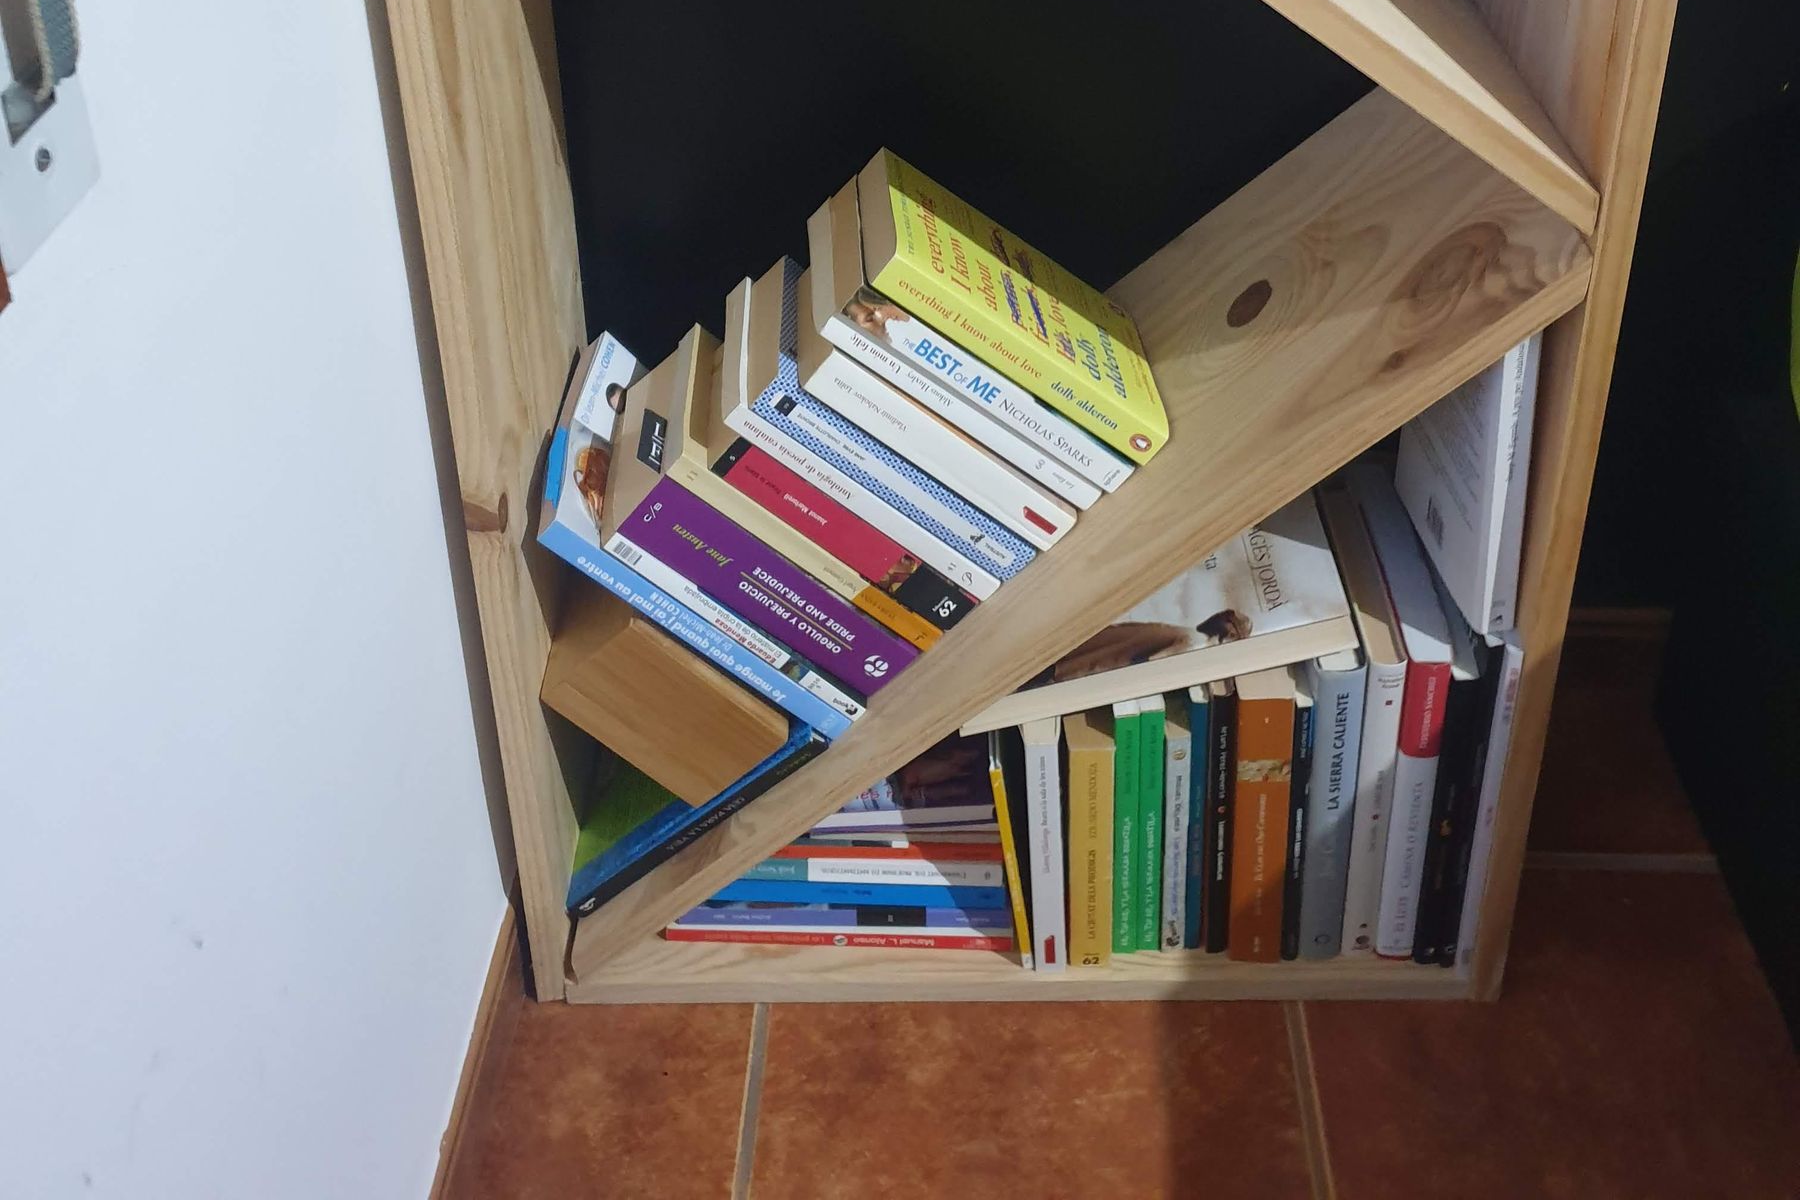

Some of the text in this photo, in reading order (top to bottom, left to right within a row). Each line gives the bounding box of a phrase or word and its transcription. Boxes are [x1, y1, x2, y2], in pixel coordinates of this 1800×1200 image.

[917, 188, 945, 275] everything
[950, 237, 971, 282] know
[976, 259, 998, 313] about
[885, 359, 902, 374] Un
[895, 277, 954, 320] everything
[952, 312, 962, 323] I
[958, 317, 990, 343] know
[988, 337, 1024, 365] about
[1019, 358, 1044, 379] love
[1048, 378, 1078, 403] dolly
[1074, 396, 1120, 430] alderton
[1076, 332, 1102, 382] dolly
[1095, 322, 1128, 399] alderton
[832, 376, 853, 394] Lolita
[902, 337, 1001, 405] THE BEST OF ME
[852, 390, 908, 432] Vladimir Nabokov
[928, 386, 953, 407] Aldous
[741, 419, 778, 449] catalana
[996, 397, 1094, 467] NICHOLAS SPARKS
[842, 443, 854, 454] EYRE
[803, 462, 816, 475] de
[670, 520, 733, 570] Jane Austen
[1246, 525, 1289, 612] AGÈS JORDÀ
[683, 583, 718, 613] embrujada
[751, 562, 807, 610] PREJUDICE
[649, 589, 681, 617] COHEN
[737, 576, 842, 656] ORGULLO Y PREJUICIO
[803, 601, 828, 623] AND
[936, 597, 957, 619] 62
[574, 553, 786, 704] Je mange quoi quand j'ai mal au ventre
[713, 616, 777, 665] Eduardo Mendoza
[733, 621, 742, 630] la
[740, 626, 751, 636] de
[824, 615, 856, 643] PRIDE
[749, 631, 776, 655] misterio
[773, 649, 783, 659] El
[1327, 691, 1350, 810] LA SIERRA CALIENTE
[1088, 763, 1097, 800] MENDOZA
[853, 936, 884, 944] Alonso
[899, 937, 934, 945] Manuel
[1088, 930, 1096, 938] LA
